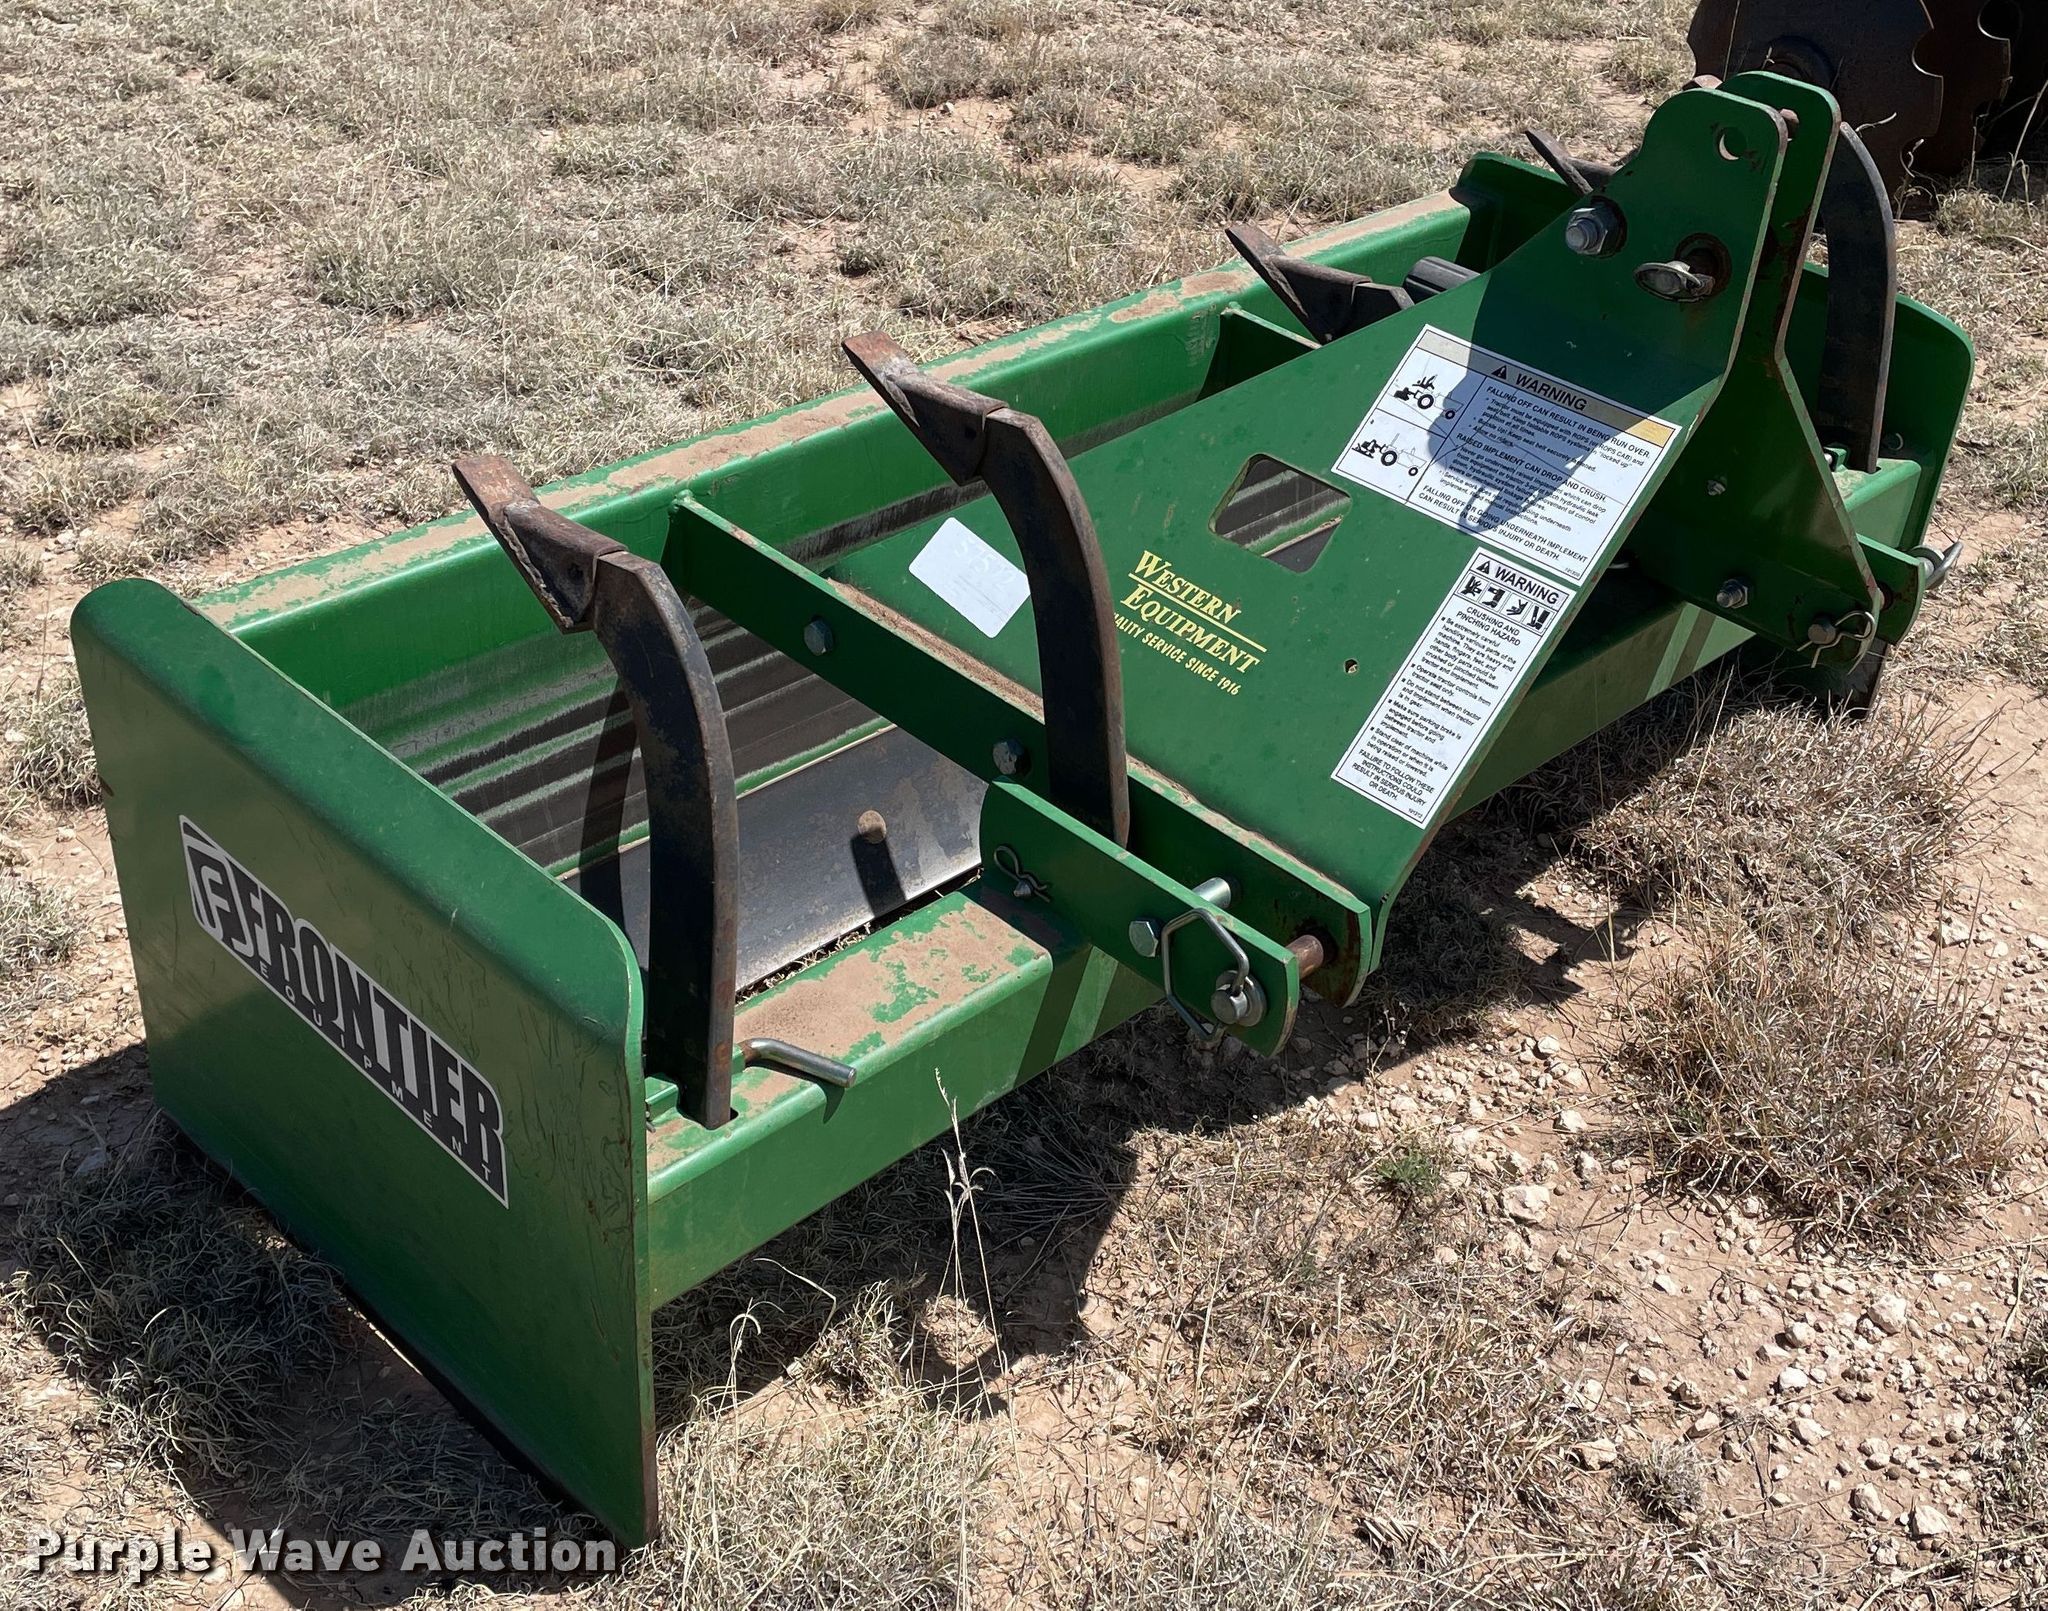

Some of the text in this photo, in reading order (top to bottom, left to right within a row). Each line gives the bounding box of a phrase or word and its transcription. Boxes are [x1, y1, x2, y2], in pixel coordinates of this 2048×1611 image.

[1513, 372, 1589, 411] WARNING
[1485, 385, 1517, 403] FALLING
[1515, 398, 1533, 409] OFF
[1531, 404, 1549, 416] CAN
[1548, 411, 1578, 428] RESULT
[1576, 423, 1587, 431] IN
[1585, 426, 1611, 441] BEING
[1609, 436, 1628, 448] RUN
[1627, 443, 1652, 458] OVER.
[1548, 431, 1566, 442] ROPS
[1455, 432, 1483, 449] RAISED
[1482, 444, 1525, 466] IMPLEMENT
[1523, 461, 1541, 474] CAN
[1540, 469, 1563, 483] DROP
[1561, 478, 1580, 490] AND
[1571, 432, 1590, 443] ROPS
[1598, 443, 1616, 454] ROPS
[1615, 450, 1633, 461] CAB)
[1631, 457, 1644, 466] and
[1463, 480, 1478, 490] work
[1538, 513, 1572, 532] underneath
[1559, 497, 1586, 512] hydraulic
[1585, 509, 1599, 518] leak
[1562, 490, 1581, 502] which
[1579, 498, 1592, 507] can
[1591, 503, 1607, 513] drop
[1573, 511, 1596, 525] control
[1417, 491, 1434, 503] CAN
[1432, 498, 1459, 514] RESULT
[1459, 510, 1468, 518] IN
[1466, 514, 1499, 532] SERIOUS
[1497, 528, 1523, 544] INJURY
[1522, 539, 1535, 549] OR
[1534, 544, 1561, 561] DEATH.
[1422, 484, 1451, 501] FALLING
[1450, 496, 1466, 508] OFF
[1465, 503, 1478, 513] OR
[1475, 508, 1500, 523] GOING
[1498, 518, 1547, 545] UNDERNEATH
[1545, 540, 1588, 563] IMPLEMENT
[1133, 550, 1241, 625] WESTERN
[1492, 566, 1561, 605] WARNING
[1120, 583, 1261, 674] EQUIPMENT
[1445, 617, 1500, 648] Be extremely careful
[1455, 610, 1522, 646] PINCHING HAZARD
[1465, 606, 1521, 636] CRUSHING AND
[1428, 643, 1497, 681] other body parts could be
[1441, 624, 1465, 640] handling
[1464, 636, 1486, 650] various
[1484, 646, 1501, 657] parts
[1506, 656, 1517, 665] the
[1461, 642, 1476, 653] They
[1475, 649, 1486, 658] are
[1484, 654, 1503, 666] heavy
[1501, 662, 1514, 672] and
[1142, 632, 1187, 665] SERVICE
[1185, 656, 1219, 683] SINCE
[1218, 676, 1242, 697] 1916
[1438, 665, 1451, 674] and
[1446, 660, 1455, 668] or
[1453, 664, 1476, 679] pinched
[1475, 675, 1499, 690] between
[1484, 662, 1497, 672] and
[1406, 679, 1482, 721] Do not stand between tractor
[1415, 664, 1492, 707] Operate tractor controls from
[1429, 680, 1442, 690] seat
[1387, 707, 1445, 740] engaged before going
[1392, 700, 1408, 711] Make
[1406, 707, 1420, 718] sure
[1419, 714, 1441, 729] parking
[1439, 725, 1456, 737] brake
[1401, 685, 1475, 727] and implement when tractor
[1374, 727, 1392, 740] Stand
[1409, 746, 1434, 763] machine
[1384, 713, 1436, 744] between tractor and
[1358, 748, 1434, 793] FAILURE TO FOLLOW THESE
[1376, 737, 1402, 755] operation
[1407, 754, 1424, 767] when
[1397, 757, 1406, 765] or
[1351, 762, 1374, 778] RESULT
[1379, 777, 1406, 795] SERIOUS
[1404, 791, 1426, 806] INJURY
[1361, 758, 1423, 796] INSTRUCTIONS COULD
[1368, 780, 1399, 800] OR DEATH.
[225, 857, 505, 1166] FRONTIER
[259, 962, 491, 1181] EQUIPMENT
